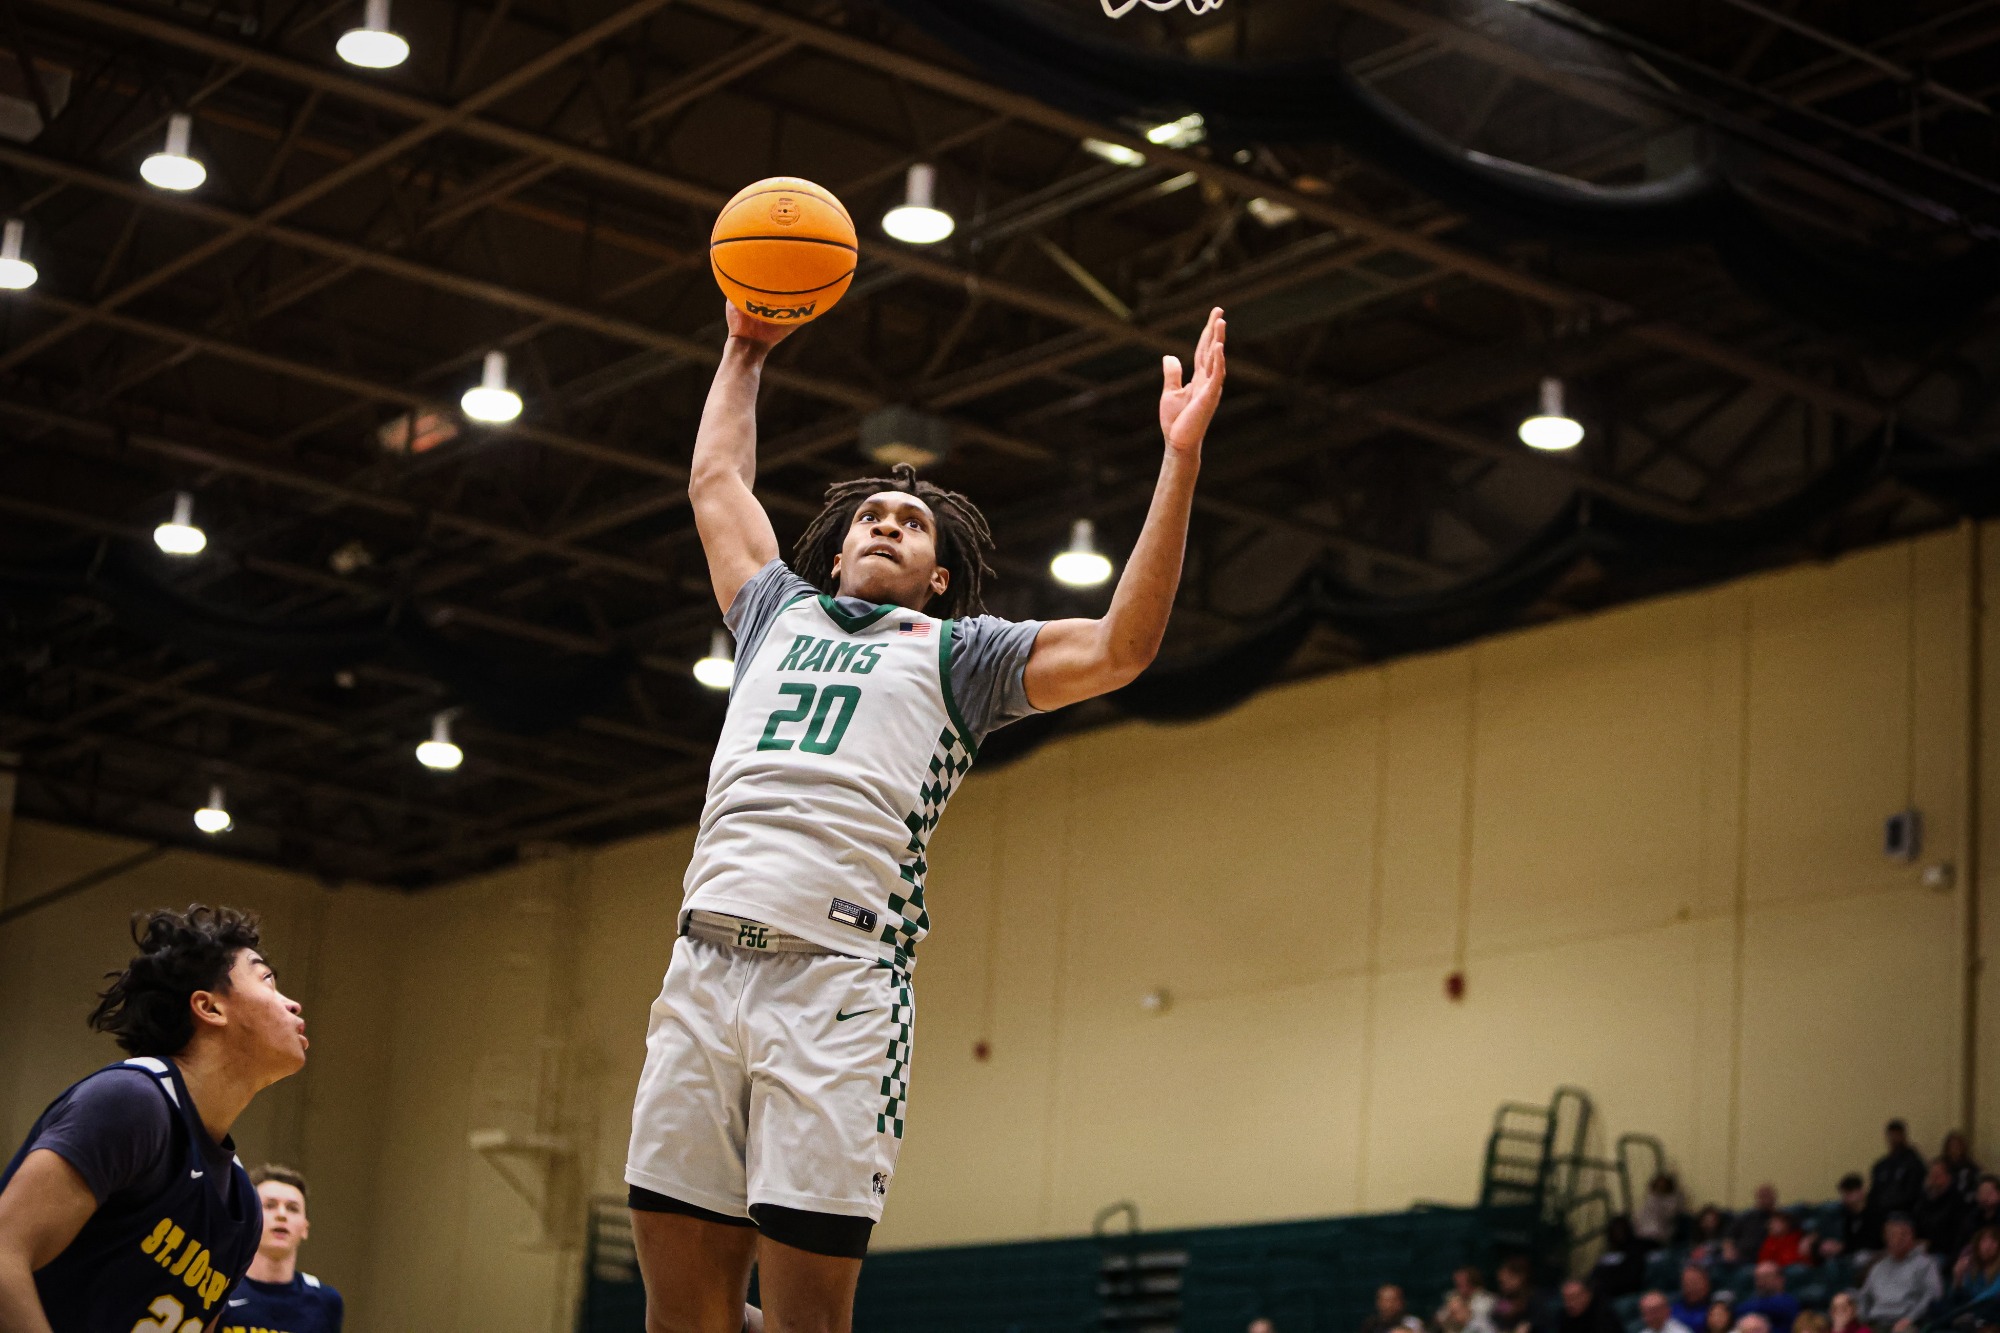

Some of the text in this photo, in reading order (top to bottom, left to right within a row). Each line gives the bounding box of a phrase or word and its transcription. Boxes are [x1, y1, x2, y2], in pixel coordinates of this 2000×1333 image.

[746, 300, 816, 318] NCAA
[776, 634, 890, 675] RAMS
[756, 682, 862, 755] 20
[863, 915, 869, 926] L
[738, 925, 769, 949] FSC
